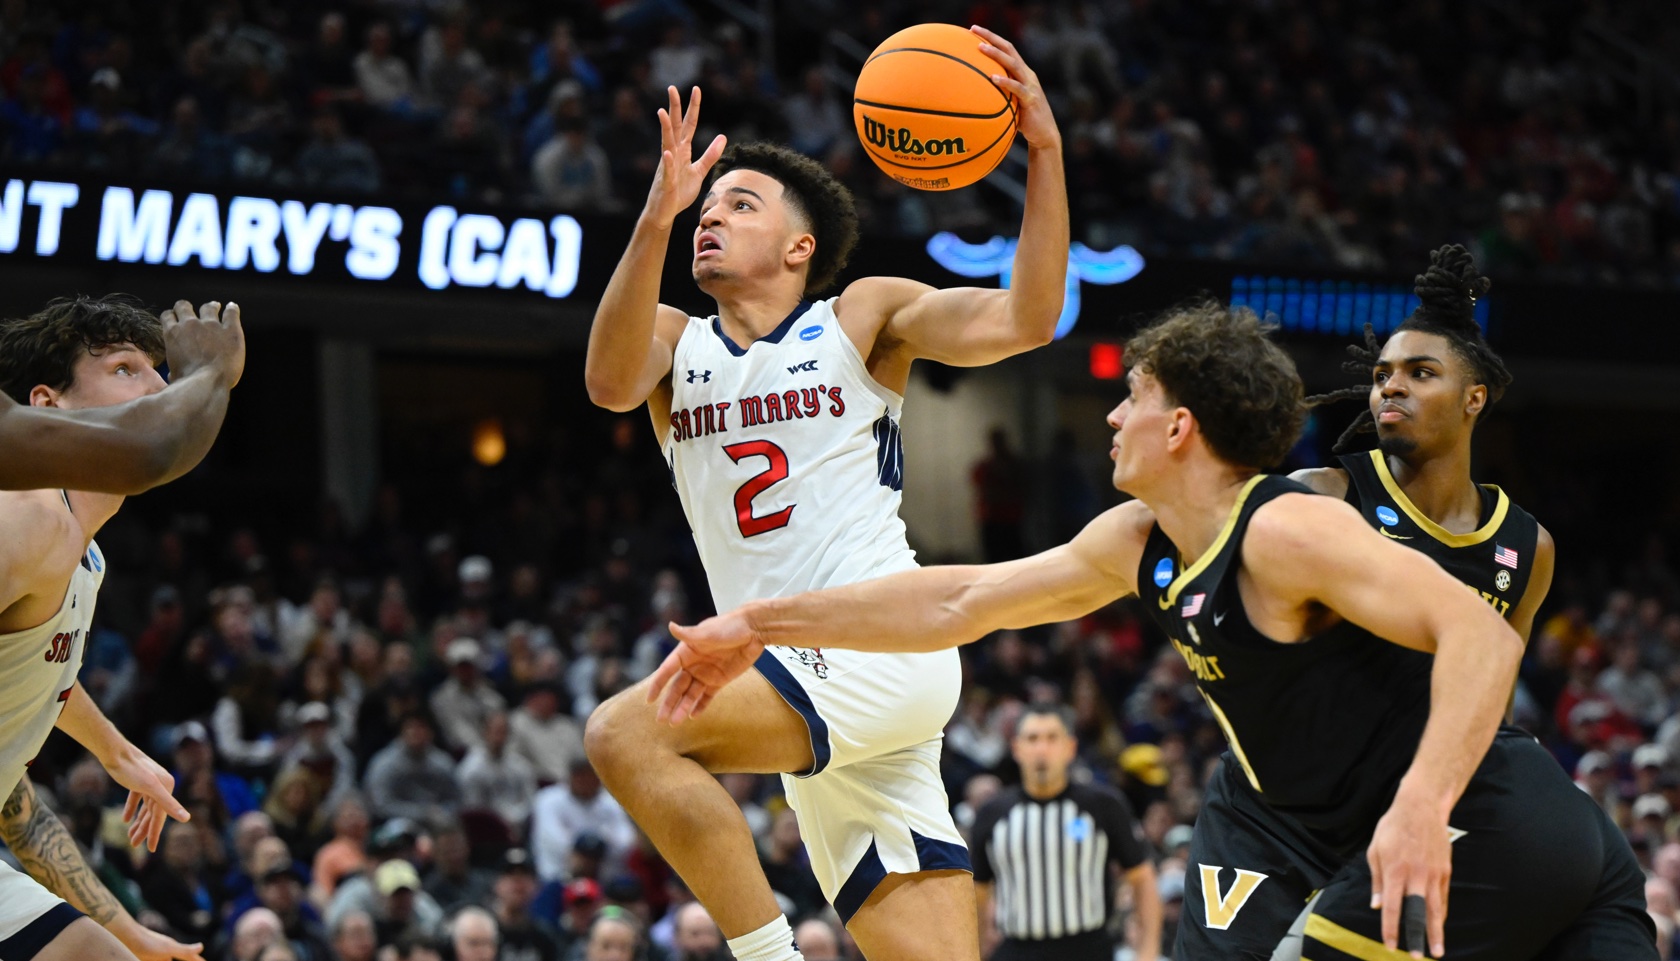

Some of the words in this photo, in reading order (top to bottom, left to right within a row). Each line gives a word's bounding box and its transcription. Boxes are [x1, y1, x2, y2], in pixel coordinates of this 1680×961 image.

[862, 113, 966, 157] Wilson
[96, 186, 403, 281] MARY'S
[418, 205, 583, 298] (CA)
[786, 360, 819, 375] WCC
[670, 401, 731, 443] SAINT
[739, 384, 846, 428] MARY'S
[721, 439, 797, 538] 2
[1198, 862, 1269, 931] V
